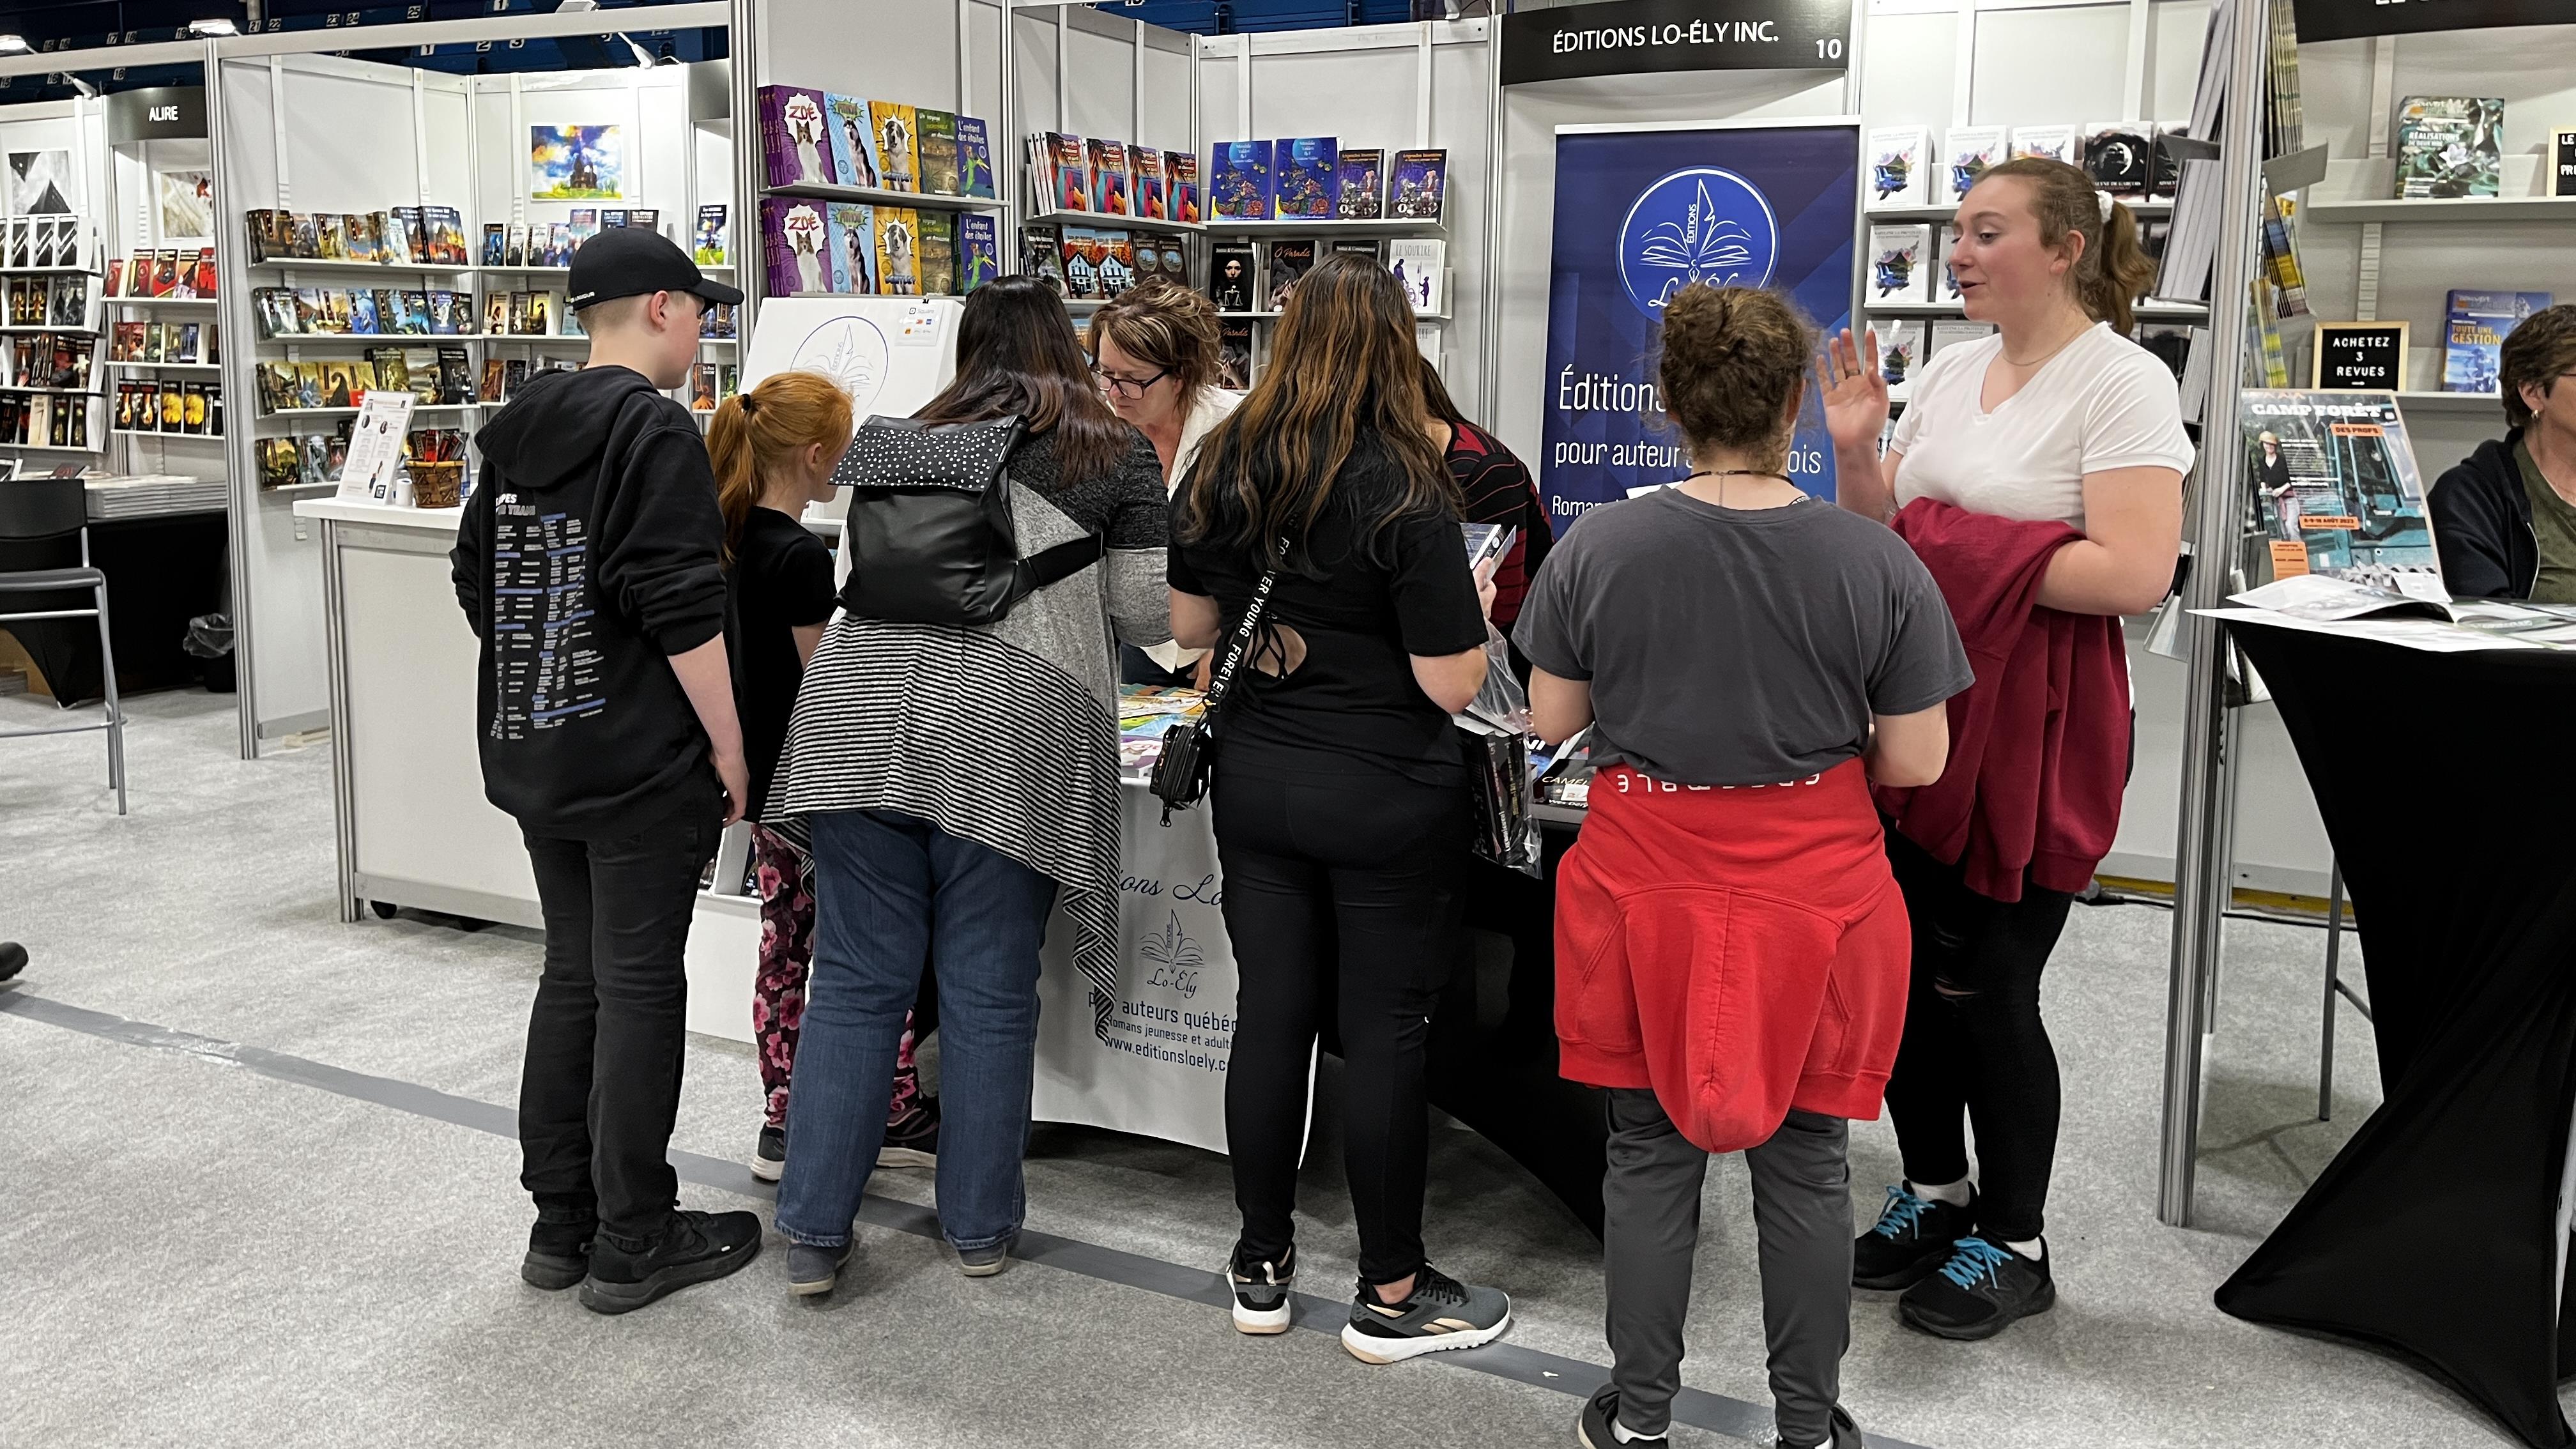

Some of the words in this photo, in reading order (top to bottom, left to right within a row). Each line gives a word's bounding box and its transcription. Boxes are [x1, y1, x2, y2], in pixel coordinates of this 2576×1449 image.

[348, 13, 358, 24] 24
[408, 7, 420, 17] 25
[250, 21, 260, 32] 21
[270, 19, 280, 29] 22
[328, 15, 339, 25] 23
[109, 33, 118, 43] 17
[178, 28, 187, 39] 19
[1552, 25, 1646, 54] ÉDITIONS
[1652, 19, 1729, 45] LO-ÉLY
[1733, 20, 1779, 42] INC.
[478, 41, 489, 50] 2
[1815, 38, 1842, 59] 10
[148, 105, 179, 121] ALIRE
[788, 103, 818, 121] ZOÉ
[958, 120, 980, 134] L'enfant
[958, 132, 967, 142] des
[2409, 131, 2460, 141] RÉALISATIONS
[2561, 134, 2575, 146] LE
[788, 213, 820, 232] ZOÉ
[965, 218, 988, 231] L'enfant
[1685, 203, 1697, 244] ÉDITIONS
[965, 229, 974, 240] des
[975, 231, 993, 242] étoiles
[1395, 244, 1402, 257] LE
[1404, 244, 1431, 257] SOURIRE
[2333, 337, 2390, 348] ACHETEZ
[2451, 334, 2502, 346] GESTION
[2356, 351, 2364, 362] 3
[2336, 366, 2386, 377] REVUES
[2251, 403, 2312, 417] CAMP
[2314, 402, 2382, 418] FORÊT
[1554, 441, 1608, 468] pour
[1239, 596, 1265, 638] YOUNG
[1146, 968, 1199, 999] Lo-Ély
[1122, 1000, 1179, 1023] auteurs
[1144, 1023, 1188, 1045] jeunesse
[1191, 1034, 1201, 1046] et
[1105, 1036, 1226, 1073] www.editionsloely.c
